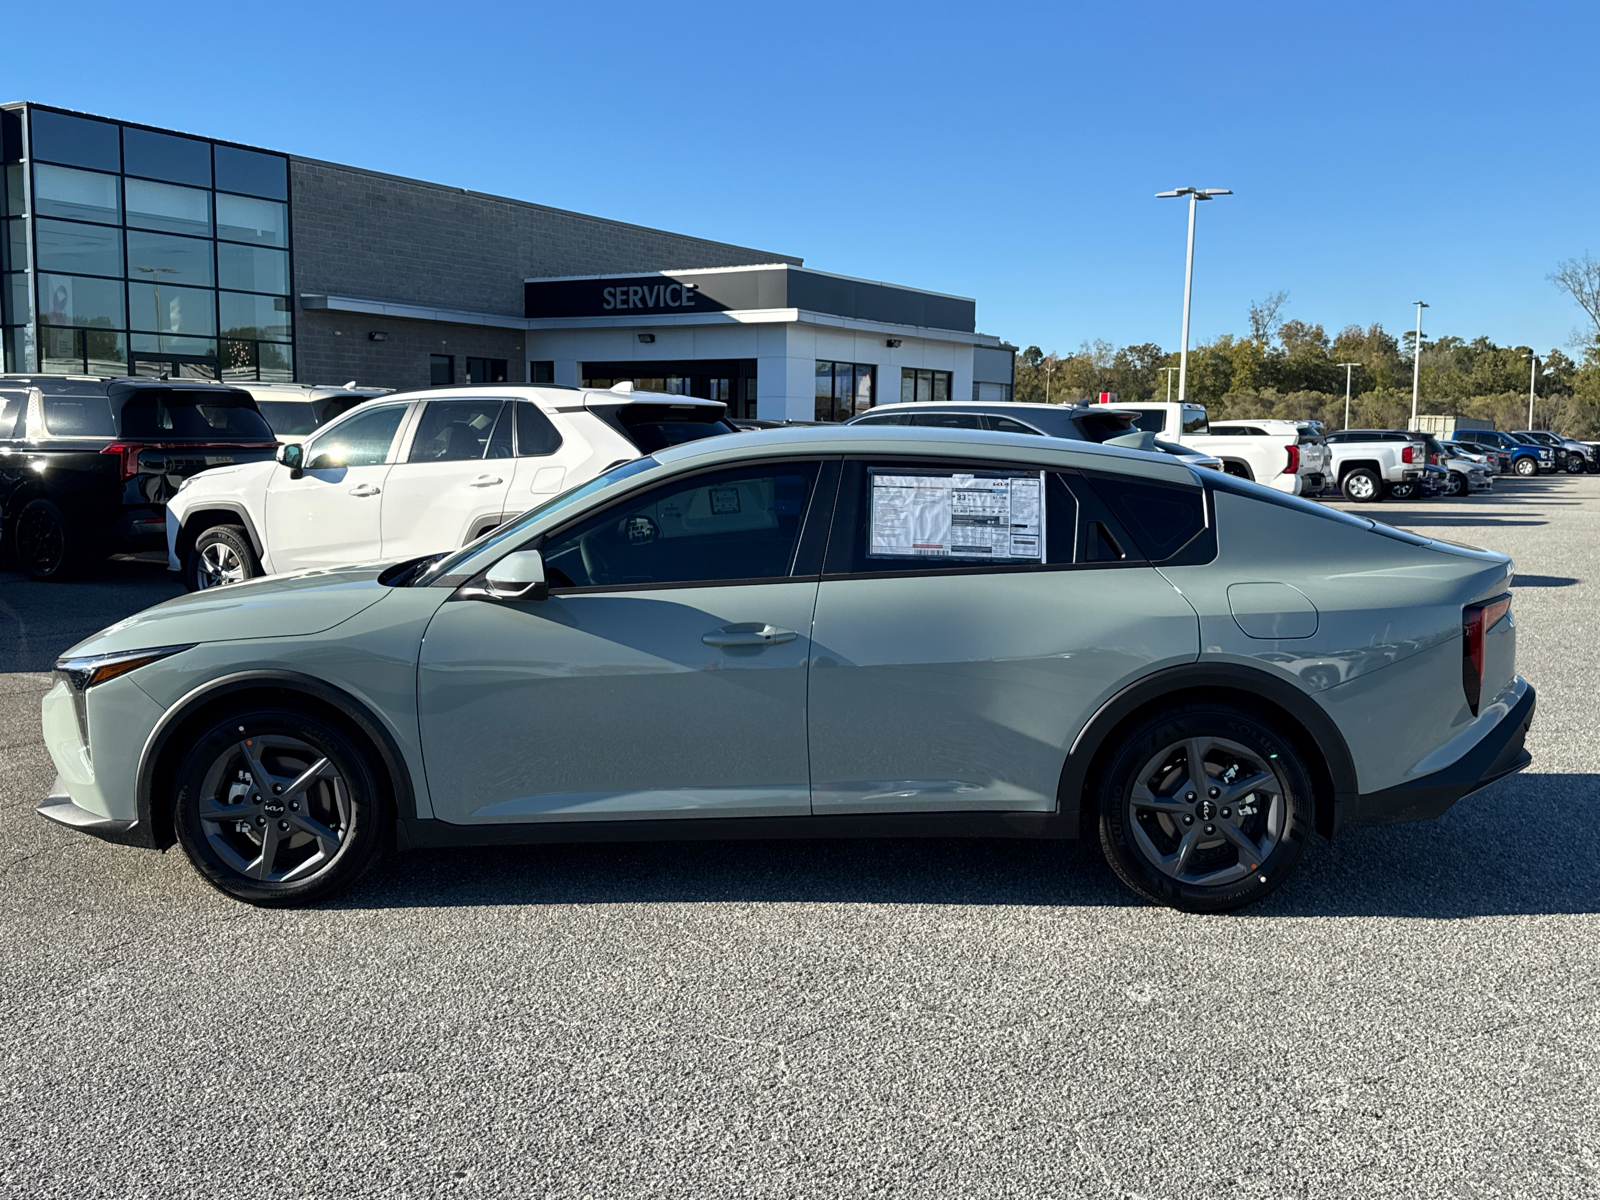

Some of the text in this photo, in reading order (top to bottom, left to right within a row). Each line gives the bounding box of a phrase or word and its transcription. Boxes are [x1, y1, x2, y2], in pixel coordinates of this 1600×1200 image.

[603, 284, 696, 309] SERVICE
[217, 532, 245, 557] VELOCITY
[264, 804, 285, 812] KIA
[1112, 785, 1126, 847] KUMHO
[1203, 800, 1214, 821] KIA
